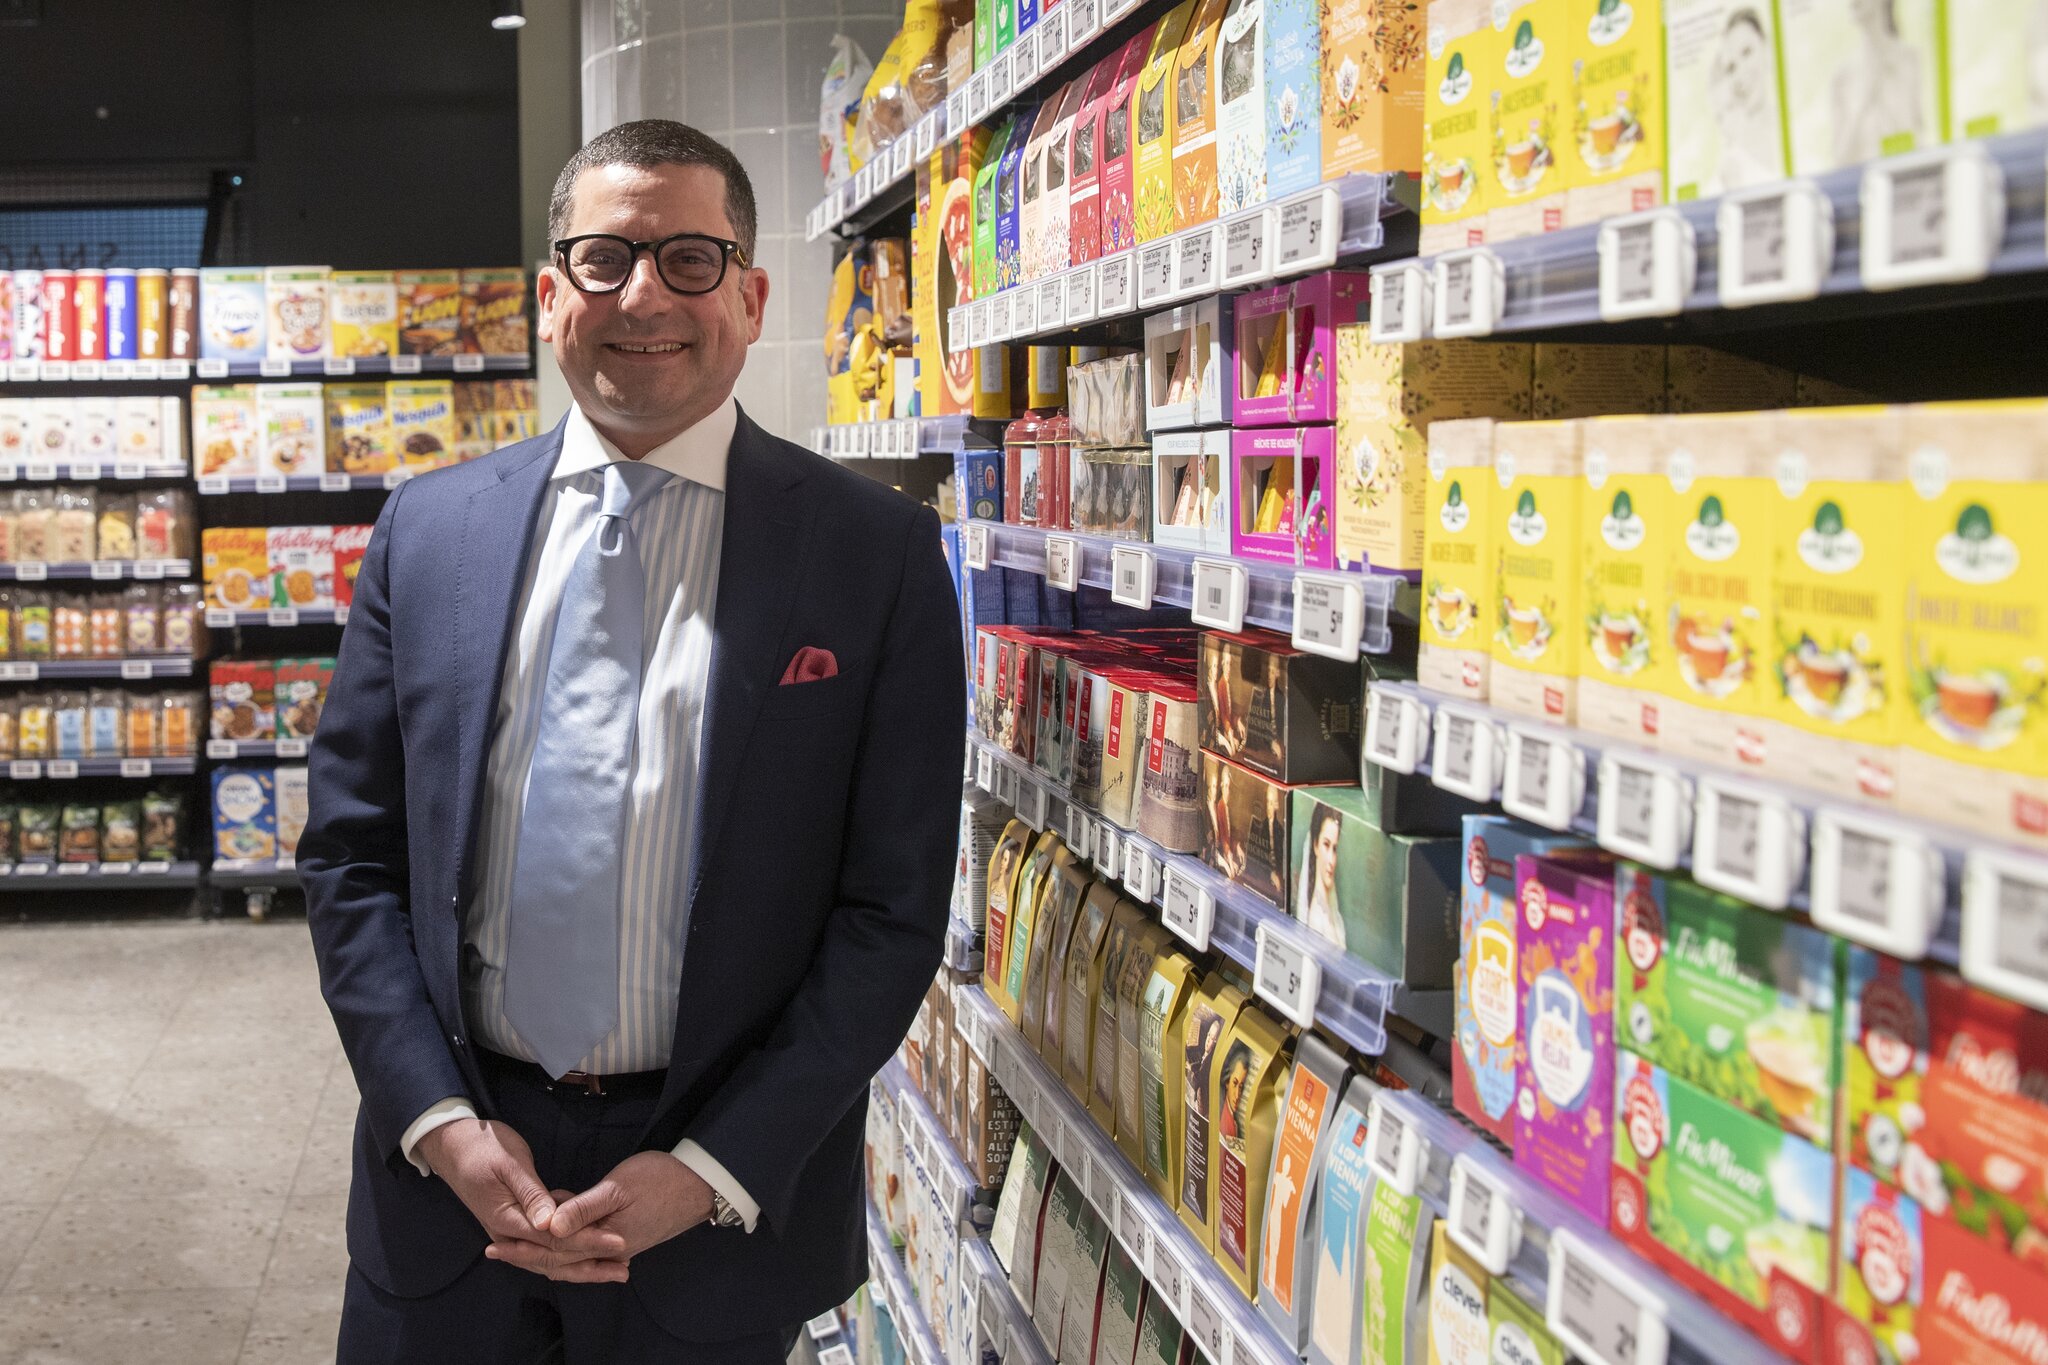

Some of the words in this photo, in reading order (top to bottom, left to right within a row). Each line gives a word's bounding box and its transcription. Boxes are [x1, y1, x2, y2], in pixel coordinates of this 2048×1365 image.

[1286, 1105, 1315, 1144] VIENNA
[1299, 1098, 1308, 1112] CUP
[1308, 1108, 1315, 1119] OF
[1328, 1152, 1364, 1194] VIENNA
[1344, 1146, 1355, 1160] CUP
[1374, 1197, 1413, 1243] VIENNA
[1443, 1275, 1481, 1318] clever
